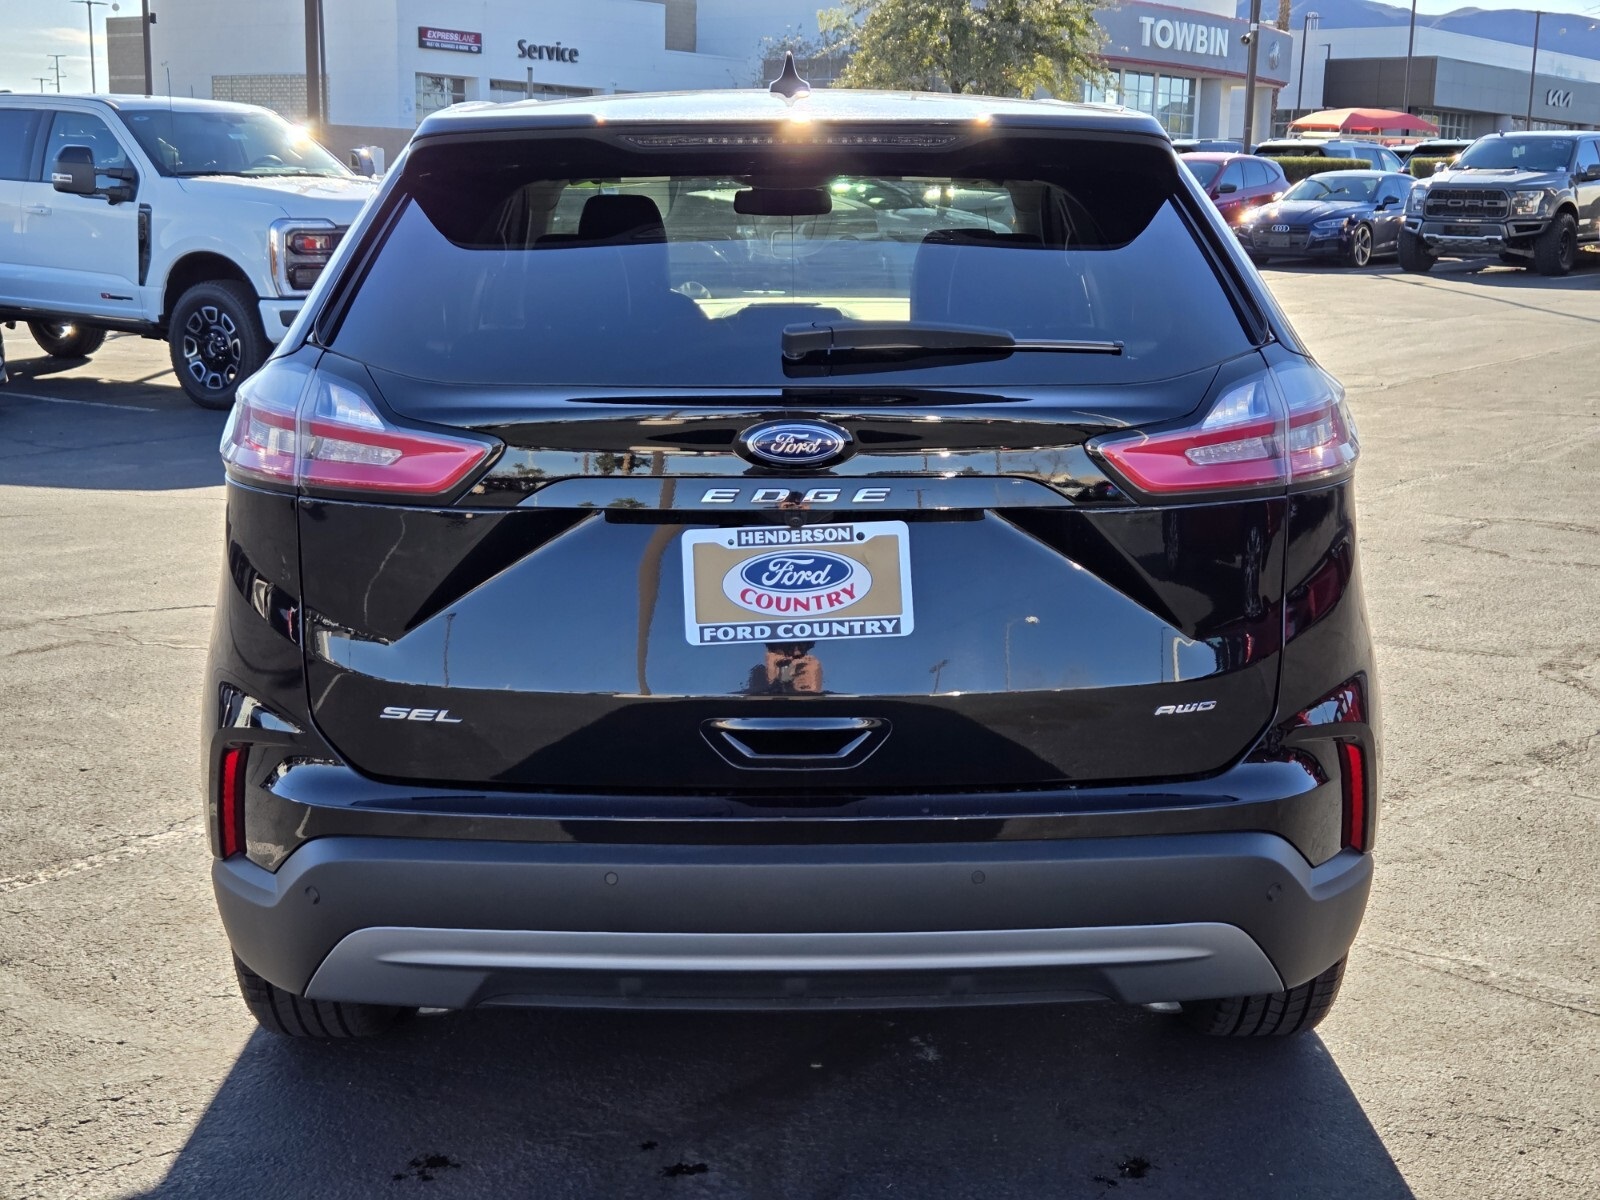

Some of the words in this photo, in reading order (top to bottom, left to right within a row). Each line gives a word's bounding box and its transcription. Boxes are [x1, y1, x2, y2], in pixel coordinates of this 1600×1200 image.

[1138, 15, 1229, 58] TOWBIN
[517, 38, 579, 63] Service
[1427, 198, 1508, 208] FORD
[770, 432, 821, 455] Ford
[700, 486, 892, 504] EDGE
[740, 526, 851, 545] HENDERSON
[761, 558, 833, 586] Ford
[739, 582, 857, 613] COUNTRY
[703, 624, 772, 642] FORD
[776, 618, 898, 639] COUNTRY
[379, 706, 463, 723] SEL
[1154, 700, 1217, 716] AWD
